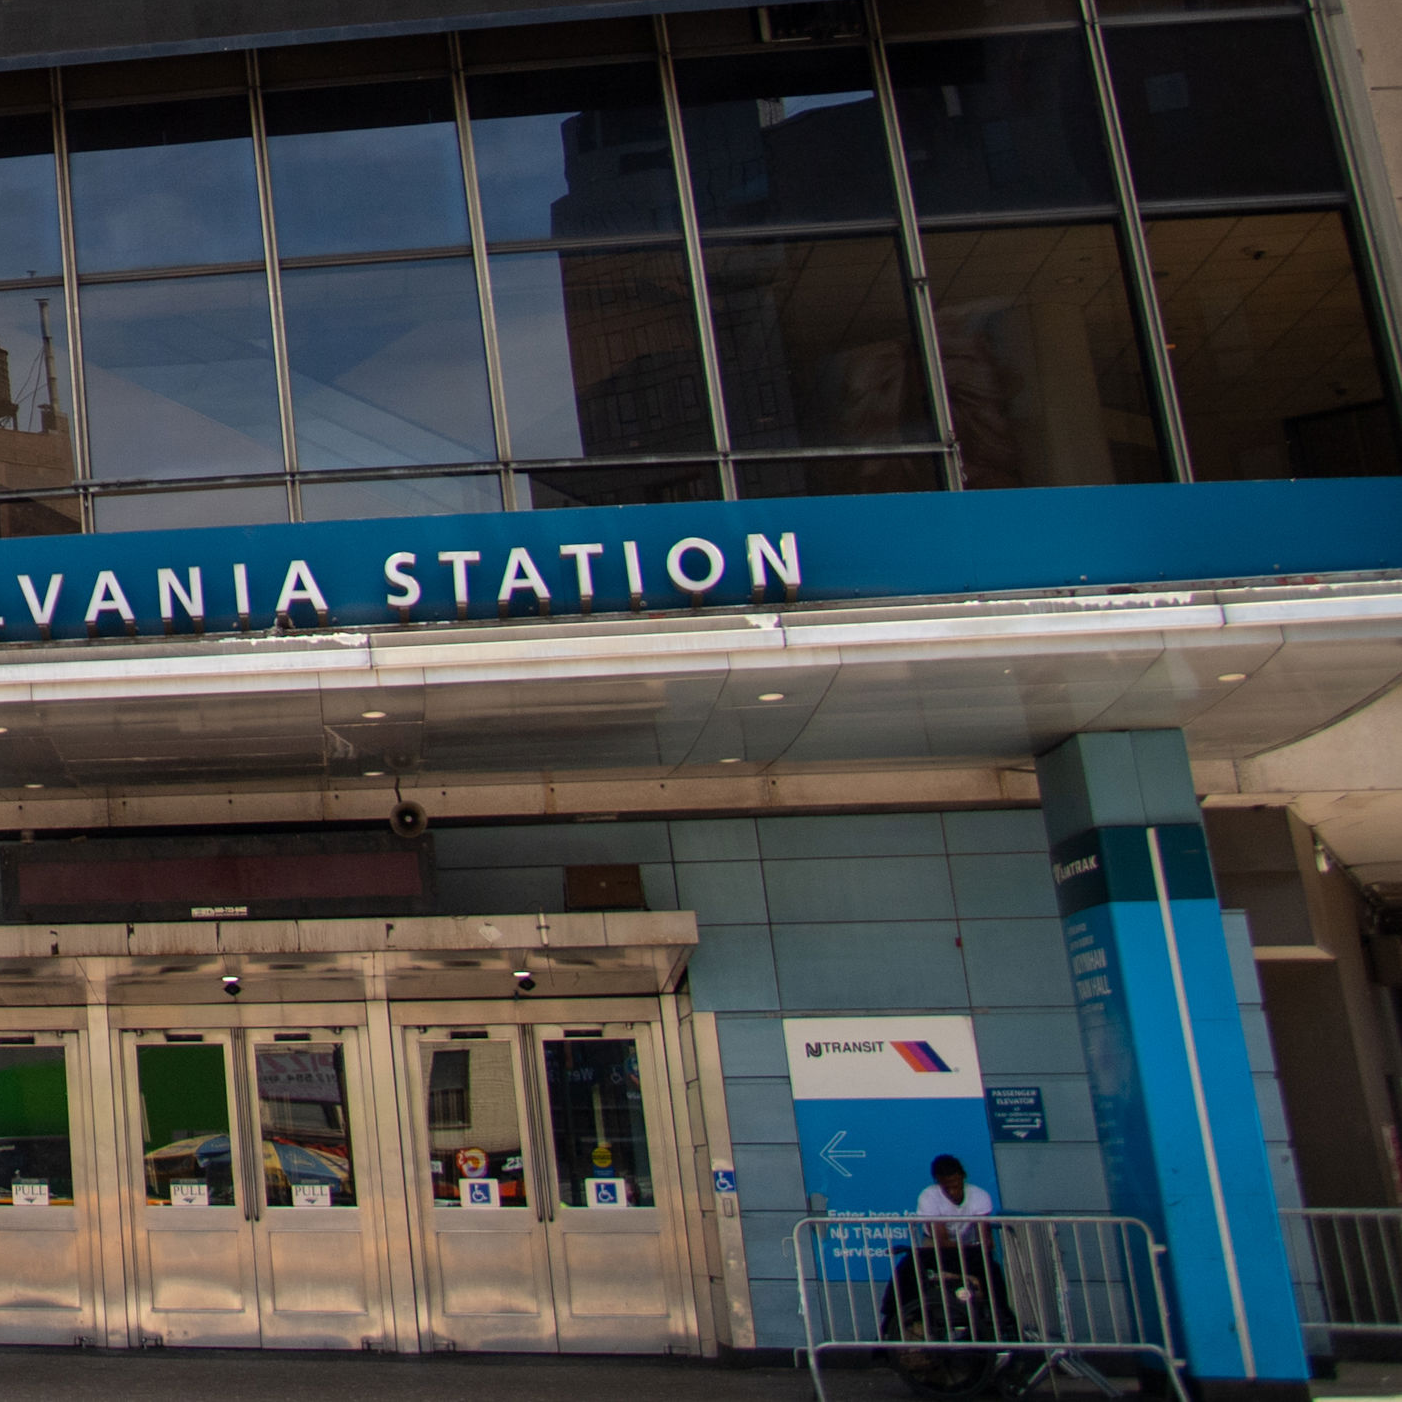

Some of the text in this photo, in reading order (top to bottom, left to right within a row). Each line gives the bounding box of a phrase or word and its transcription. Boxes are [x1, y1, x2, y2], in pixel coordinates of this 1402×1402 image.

[384, 532, 802, 609] STATION
[822, 1041, 885, 1053] TRANSIT
[14, 1184, 46, 1196] PULL
[173, 1185, 205, 1196] PULL
[294, 1185, 329, 1196] PULL
